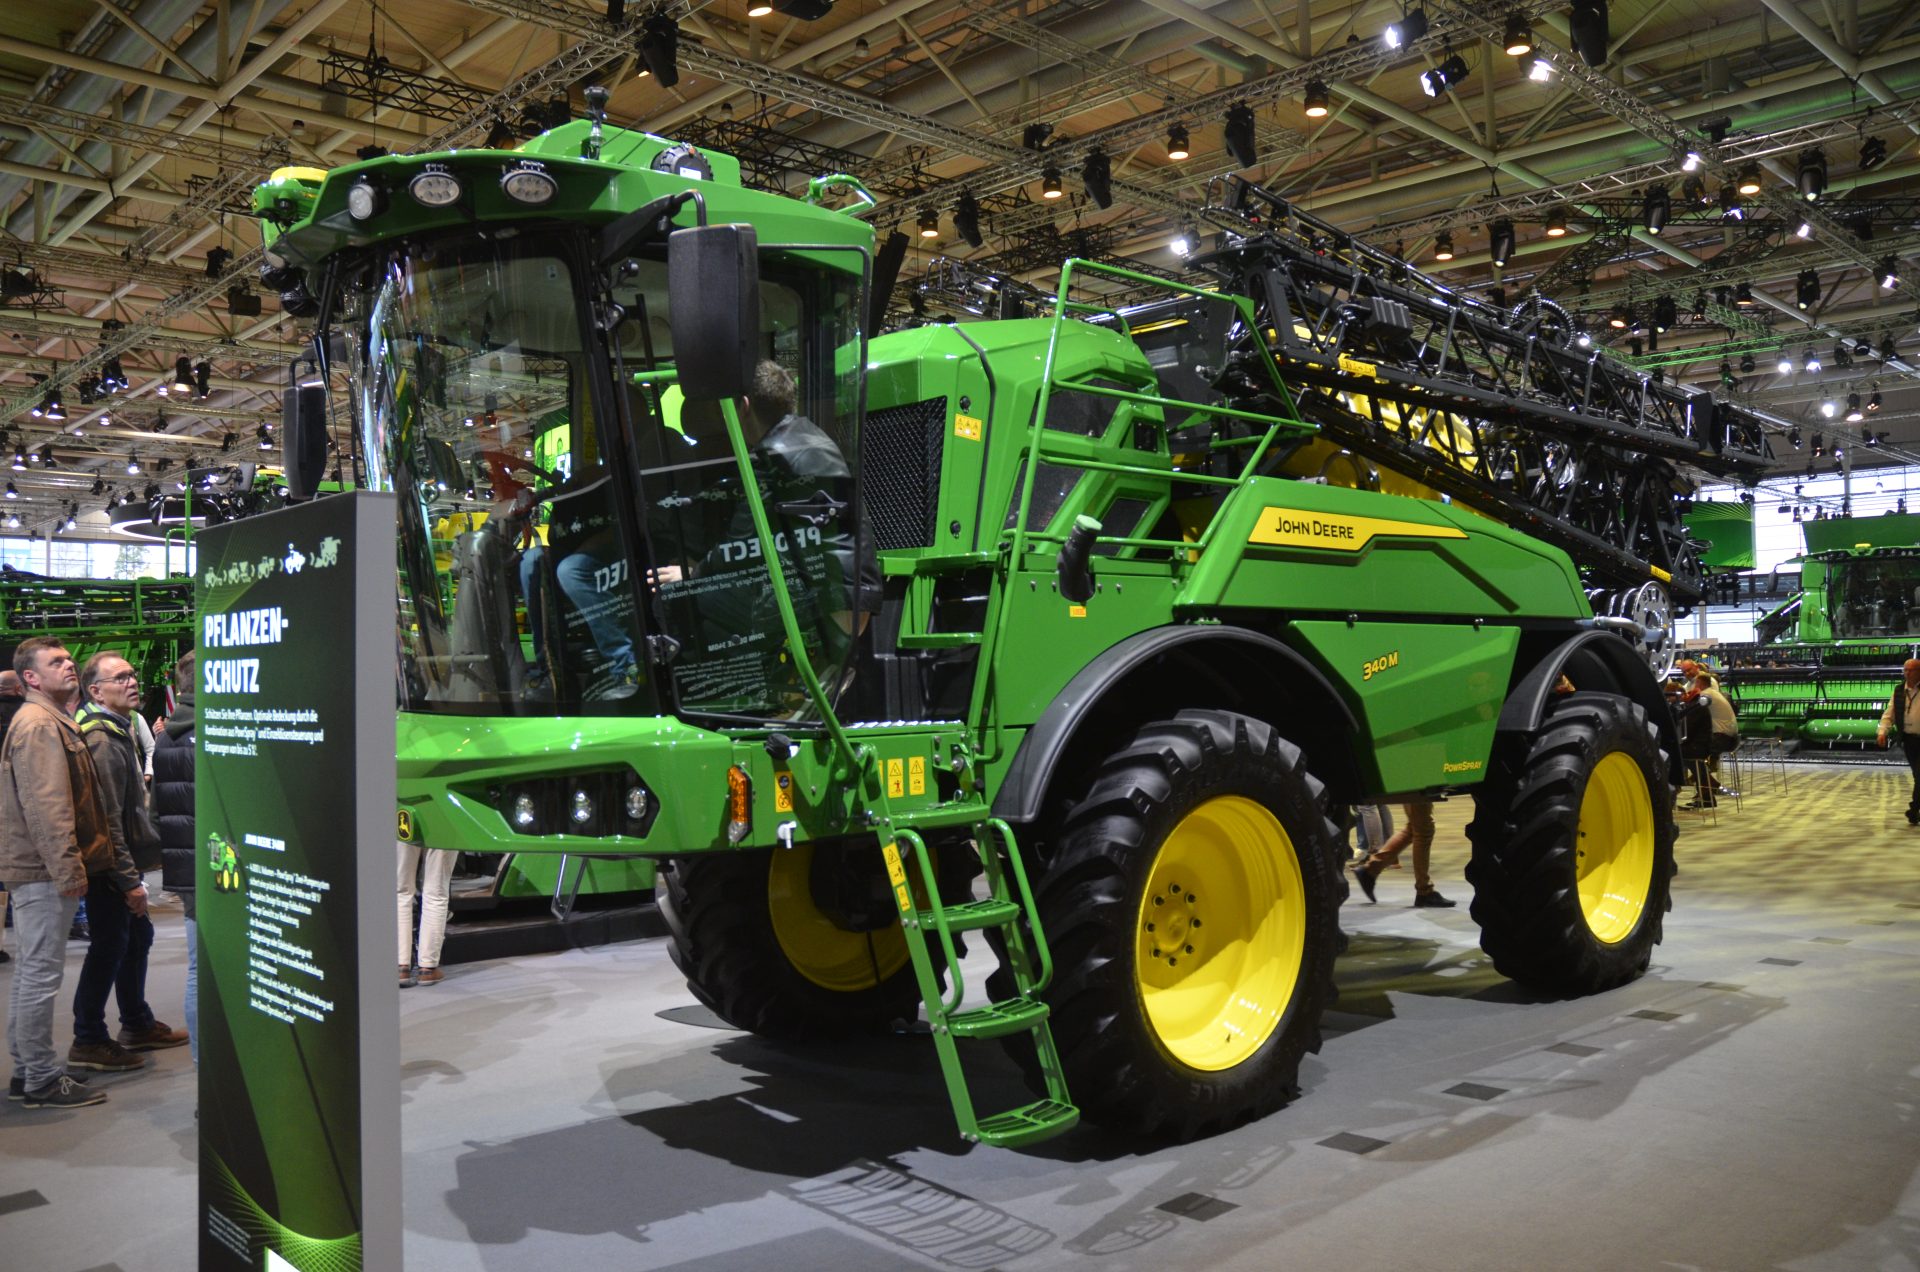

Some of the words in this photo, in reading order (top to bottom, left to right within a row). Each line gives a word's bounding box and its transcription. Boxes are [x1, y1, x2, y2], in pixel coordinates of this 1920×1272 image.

[1275, 517, 1310, 536] JOHN
[1313, 520, 1355, 540] DEERE
[204, 607, 289, 648] PFLANZEN-
[204, 658, 260, 694] SCHUTZ
